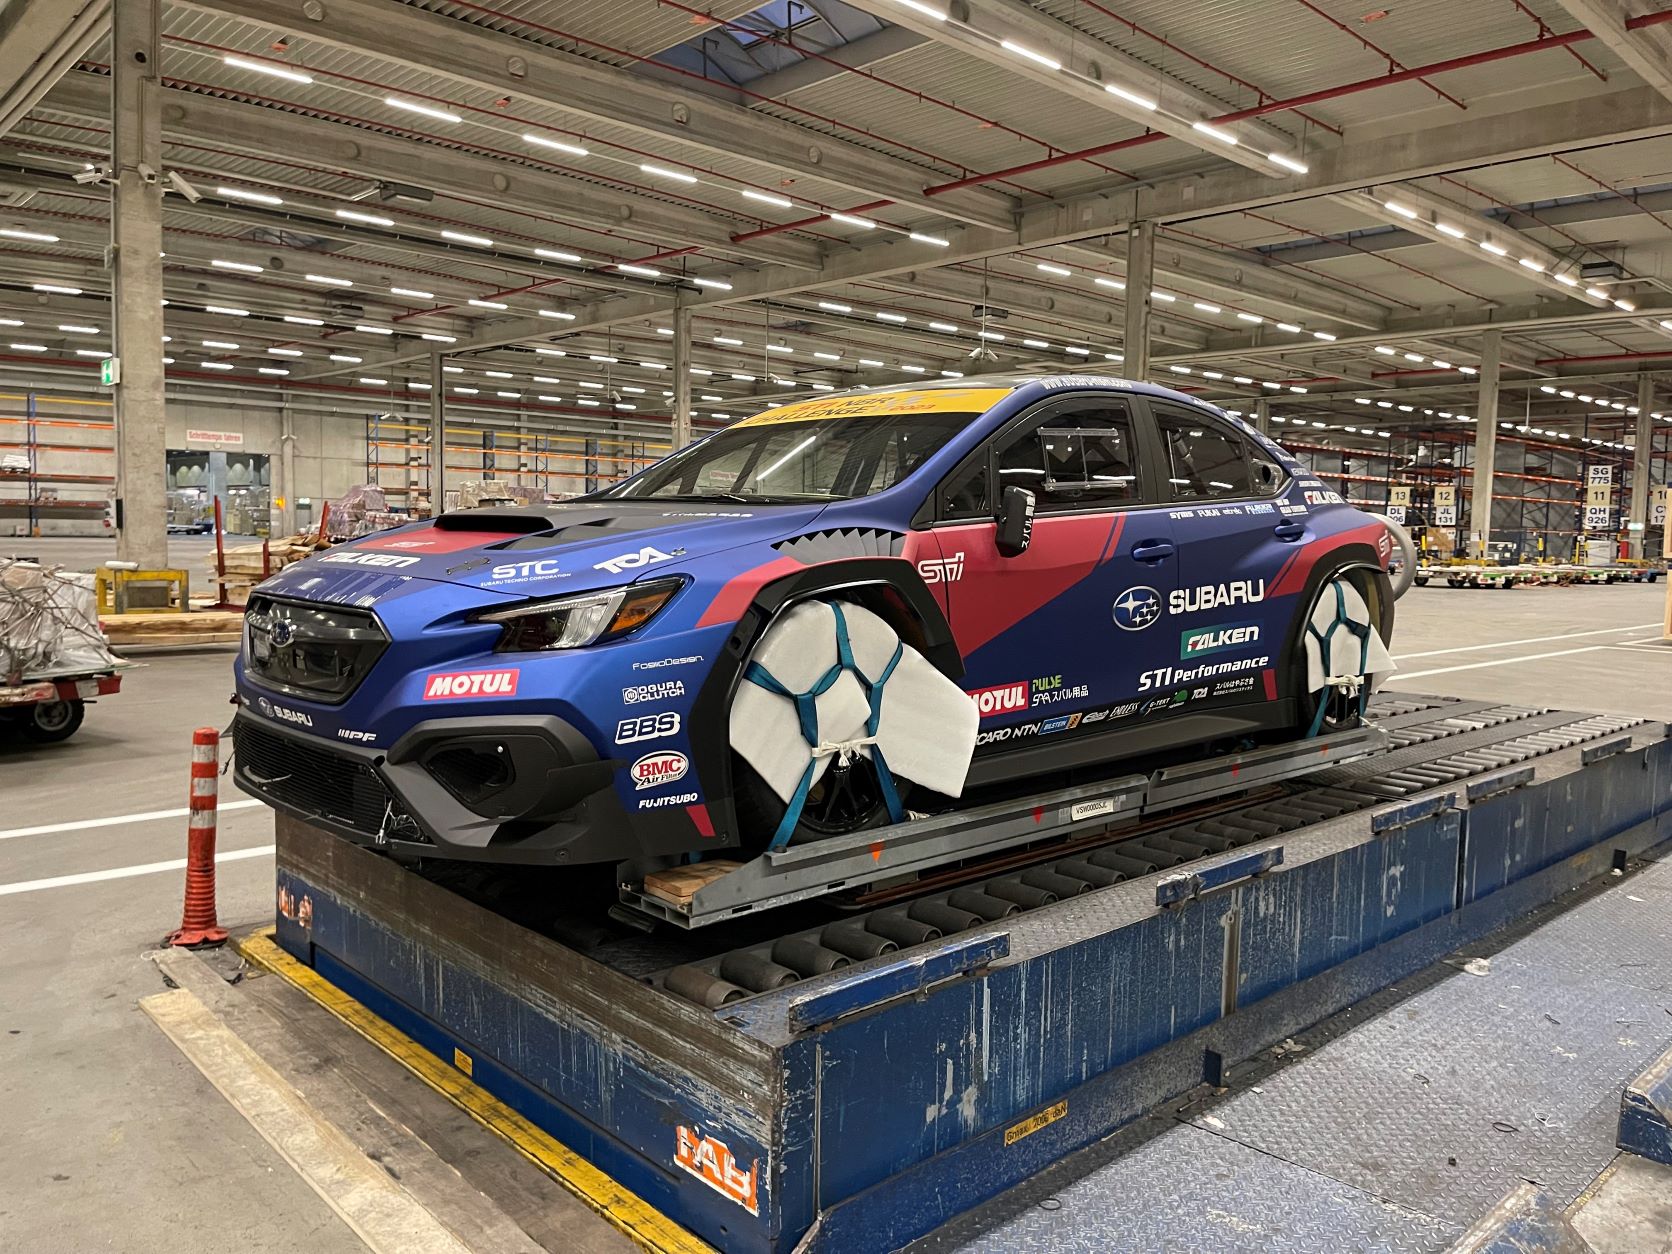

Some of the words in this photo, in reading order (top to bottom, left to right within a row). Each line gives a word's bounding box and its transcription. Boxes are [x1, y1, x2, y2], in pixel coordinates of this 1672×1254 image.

[1593, 467, 1609, 476] SG
[1591, 476, 1610, 485] 775
[1303, 490, 1346, 505] FALKEN
[1395, 491, 1406, 501] 13
[1439, 491, 1451, 501] 12
[1593, 491, 1605, 501] 11
[1589, 507, 1606, 516] QH
[1655, 505, 1667, 514] C
[1389, 515, 1404, 523] 06
[1438, 516, 1454, 524] 131
[1587, 516, 1607, 525] 926
[1653, 515, 1666, 524] 17
[317, 552, 421, 568] FALKEN
[491, 559, 560, 579] STC
[480, 579, 504, 588] SUBARU
[504, 576, 529, 584] TECHNO
[529, 572, 572, 582] CORPORATION
[1168, 578, 1265, 615] SUBARU
[1186, 625, 1260, 653] FALKEN
[1137, 667, 1173, 692] STI
[1173, 656, 1269, 684] Performance
[428, 674, 513, 696] MOTUL
[638, 680, 684, 694] OGURA
[1032, 674, 1063, 693] PULSE
[639, 688, 685, 702] CLUTCH
[1052, 684, 1089, 704] スバル用品
[273, 705, 313, 727] SUBARU
[615, 711, 681, 745] BBS
[1012, 722, 1041, 739] NTN
[975, 728, 1012, 746] CARO
[638, 758, 682, 778] BMC
[641, 776, 660, 788] Air
[638, 792, 698, 809] FUJITSUBO
